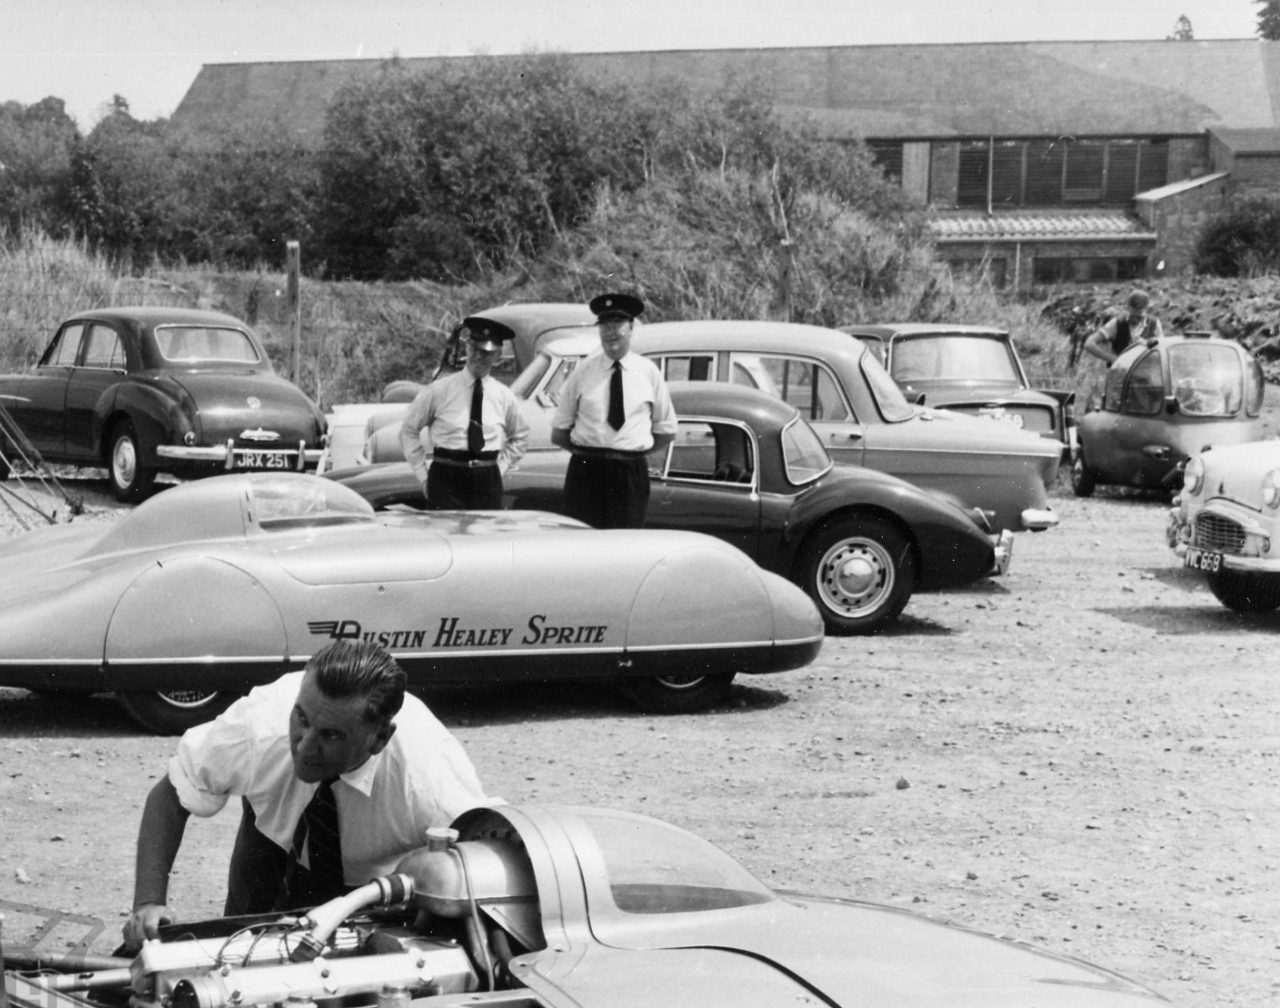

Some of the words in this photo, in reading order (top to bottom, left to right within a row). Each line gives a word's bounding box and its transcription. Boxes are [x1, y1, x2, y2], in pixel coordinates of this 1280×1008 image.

[237, 453, 263, 468] JRX
[266, 453, 289, 468] 251
[432, 617, 514, 648] HEALEY
[522, 614, 608, 645] SPRITE
